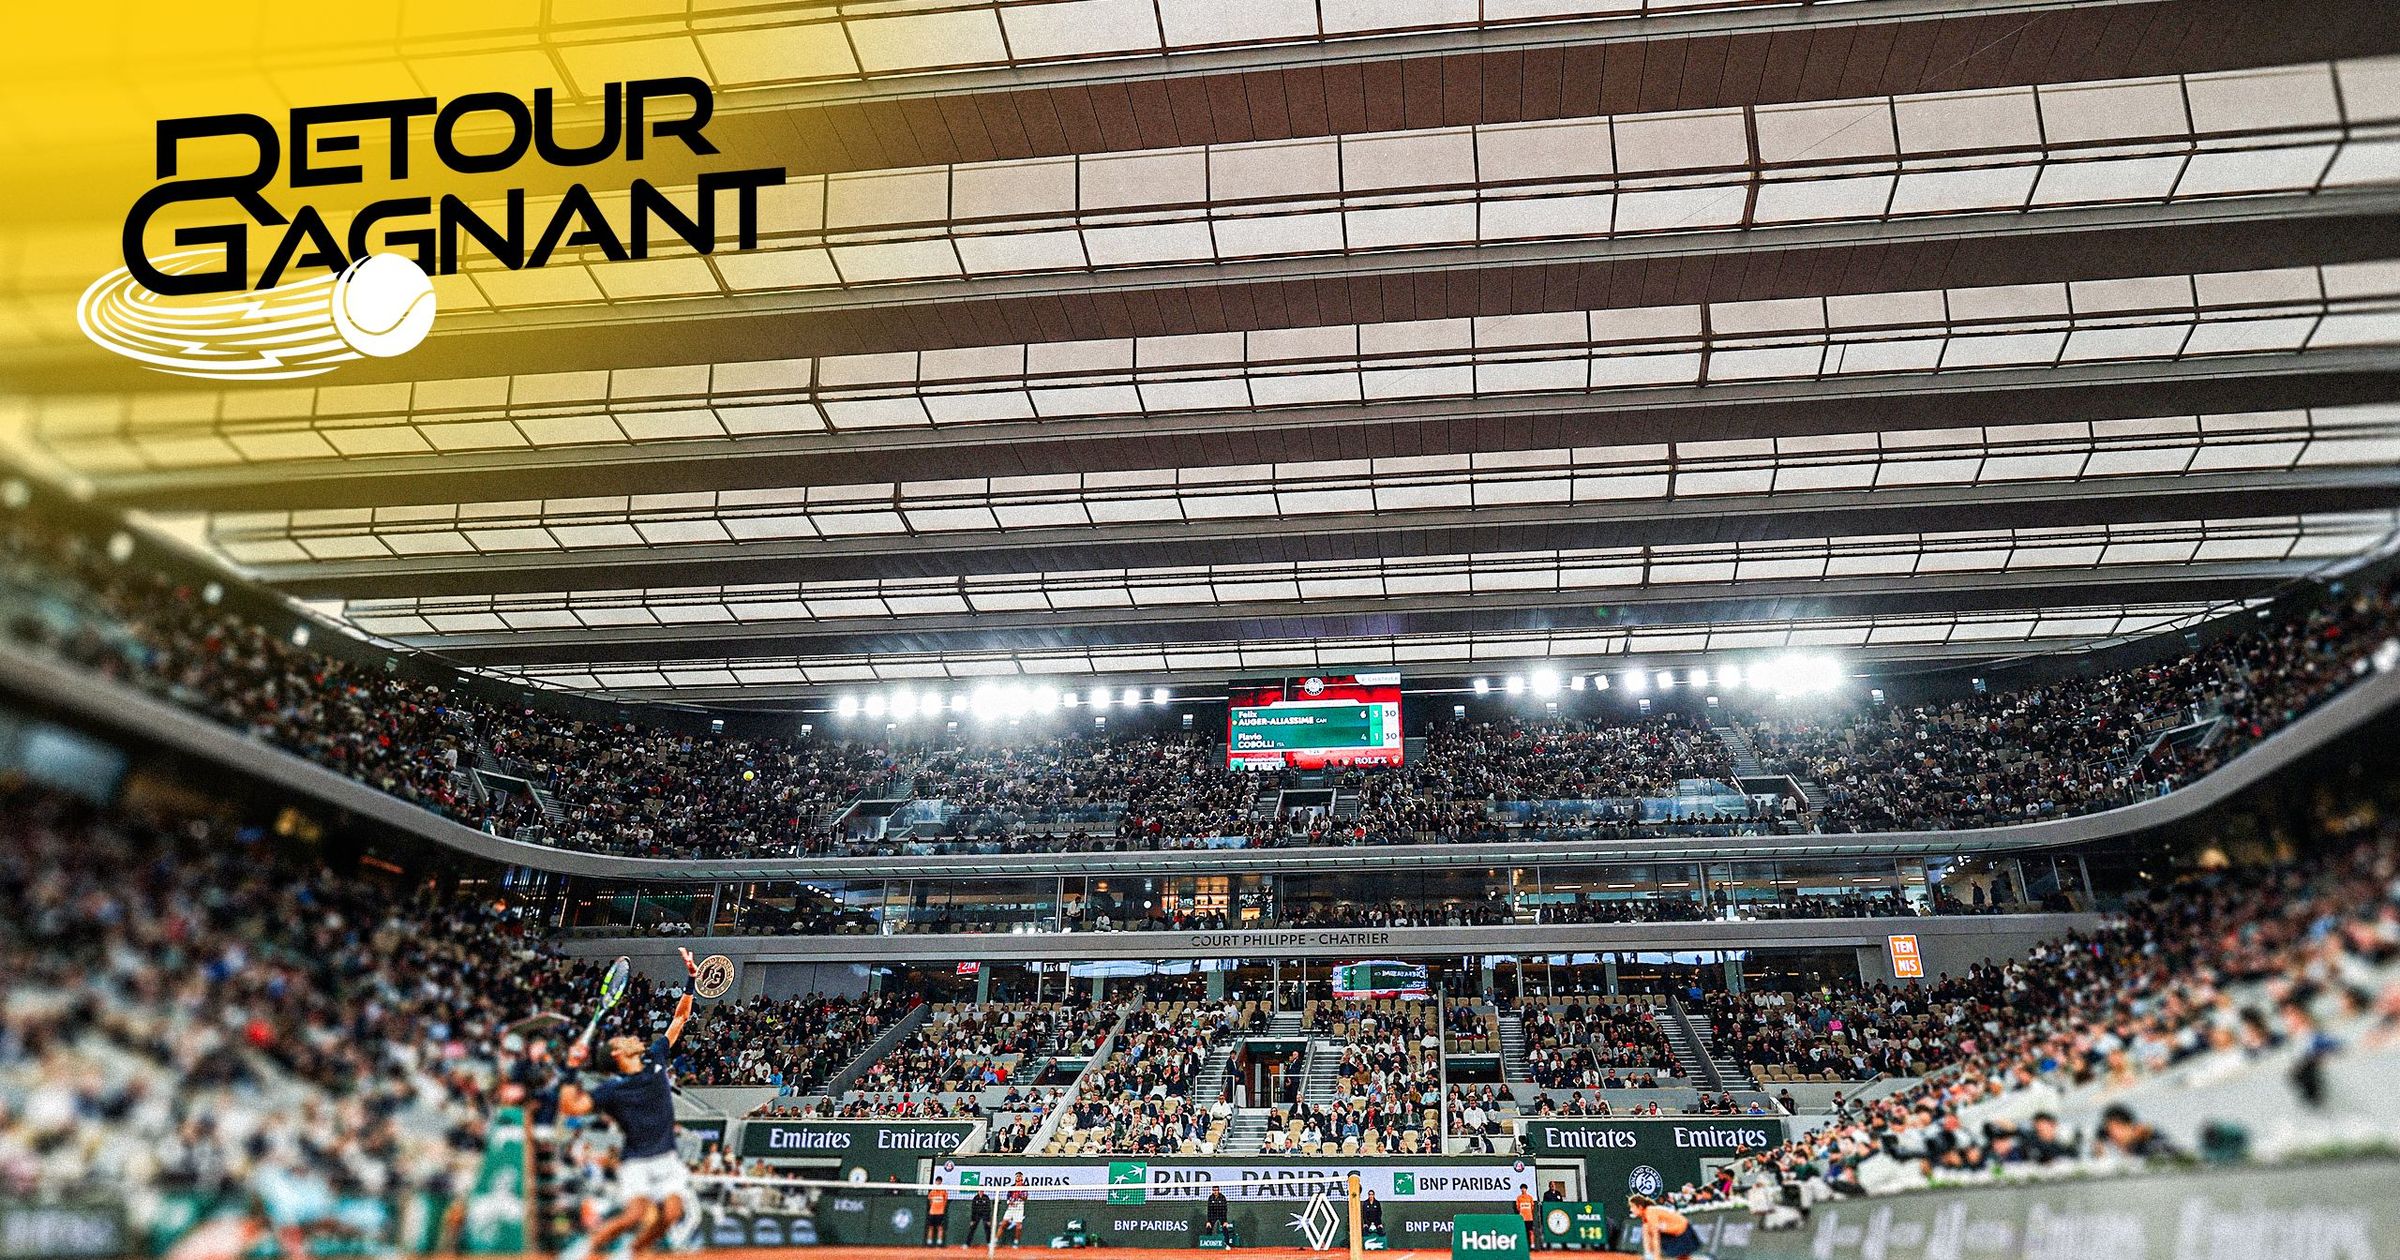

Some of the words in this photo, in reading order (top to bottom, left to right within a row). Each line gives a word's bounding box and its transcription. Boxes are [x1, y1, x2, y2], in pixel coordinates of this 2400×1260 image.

[1360, 710, 1367, 719] 6
[1360, 733, 1367, 741] 4
[1385, 732, 1397, 740] 30
[1191, 934, 1240, 947] COURT
[1243, 933, 1306, 946] PHILIPPE
[1318, 932, 1389, 945] CHATRIER
[1894, 940, 1914, 953] TEN
[1898, 959, 1918, 972] NIS
[769, 1127, 851, 1149] Emirates
[877, 1128, 960, 1149] Emirates
[1545, 1126, 1637, 1148] Emirates
[1674, 1125, 1767, 1148] Emirates
[1153, 1170, 1212, 1197] BNP
[1419, 1177, 1448, 1191] BNP
[1452, 1177, 1511, 1191] PARIBAS
[1114, 1219, 1138, 1231] BNP
[1140, 1219, 1189, 1232] PARIBAS
[1405, 1221, 1431, 1232] BNP
[1461, 1229, 1518, 1250] Haier
